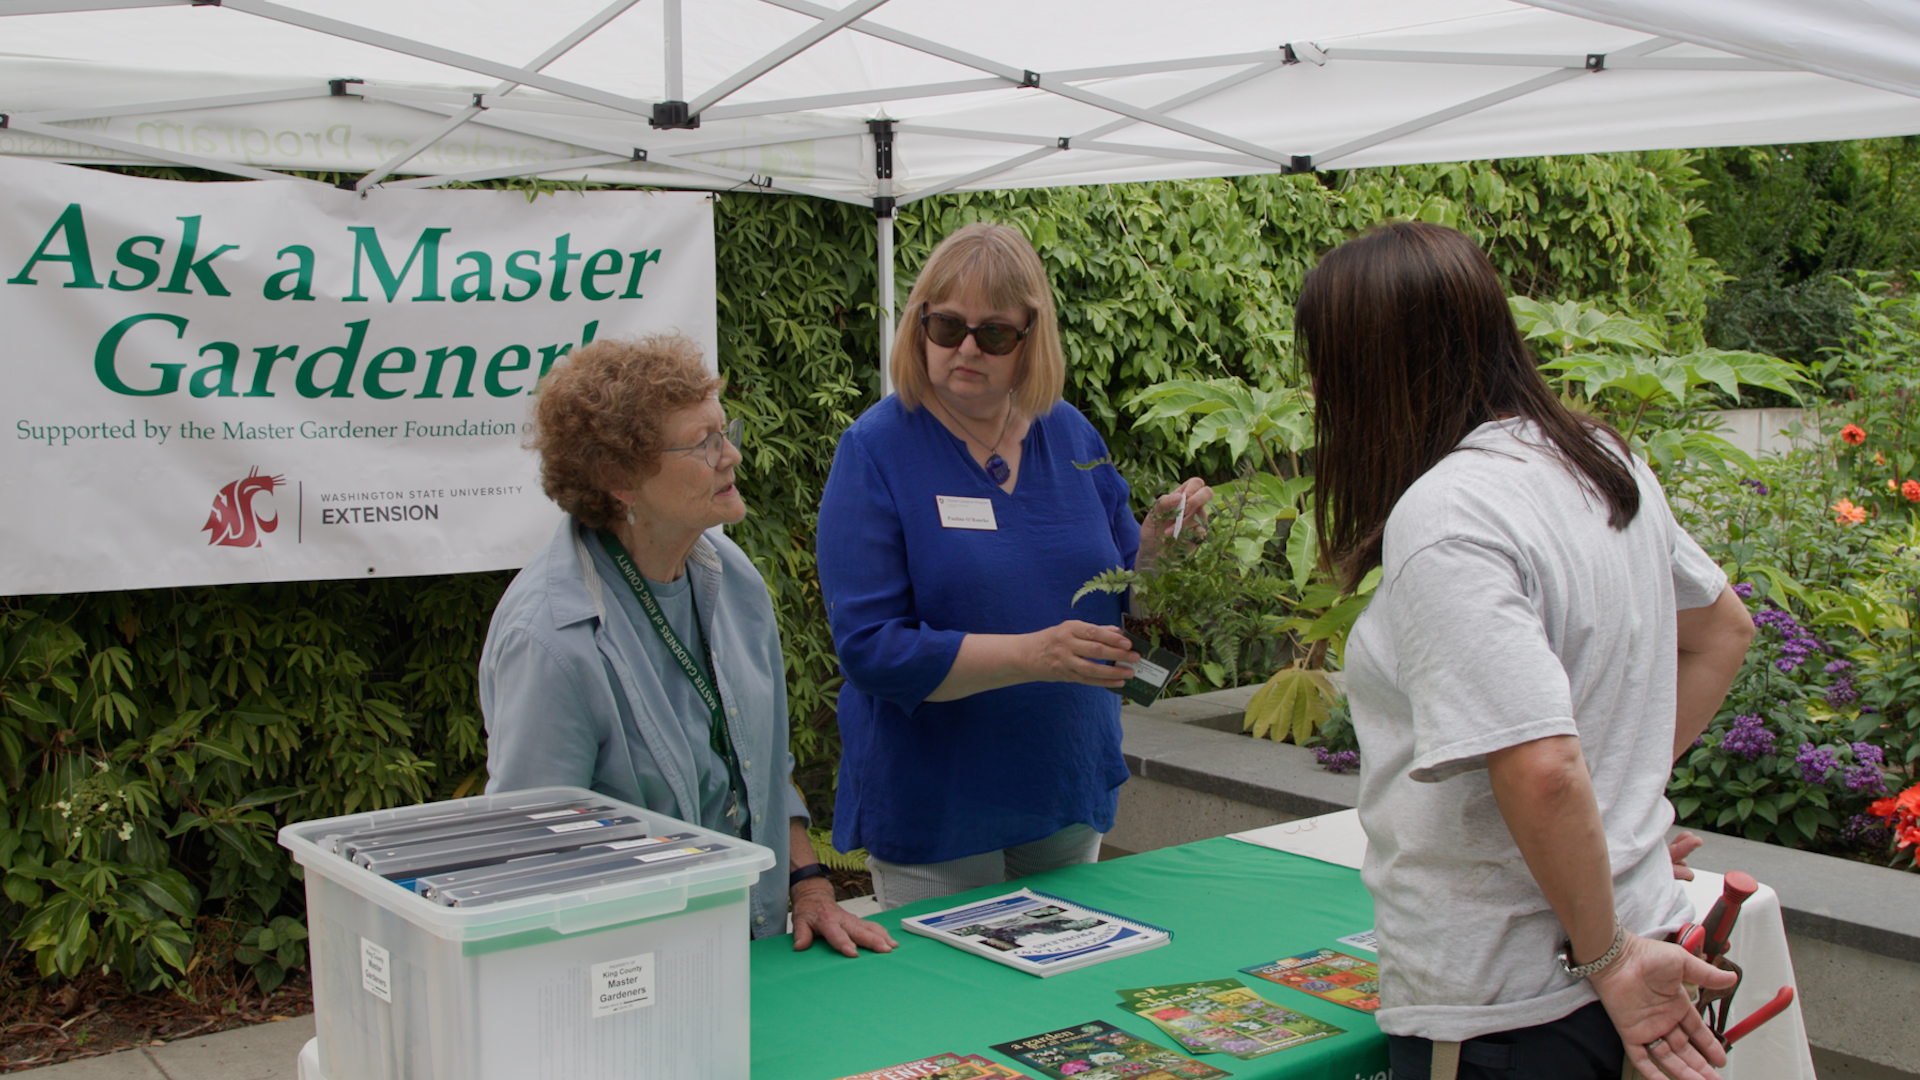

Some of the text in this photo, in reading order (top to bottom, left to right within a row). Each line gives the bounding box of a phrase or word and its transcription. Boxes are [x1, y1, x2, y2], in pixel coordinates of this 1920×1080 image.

[7, 203, 662, 303] Ask a Master
[16, 419, 136, 446] Supported
[144, 419, 172, 445] by
[180, 420, 215, 440] the
[222, 421, 295, 440] Master
[300, 420, 398, 439] Gardener
[404, 419, 516, 438] Foundation
[320, 486, 523, 502] WASHINGTON STATE UNIVERSITY
[322, 504, 439, 525] EXTENSION
[614, 554, 645, 592] COUNTY
[640, 591, 658, 616] KING
[660, 625, 698, 677] GARDENERS
[694, 675, 718, 711] MASTER
[602, 965, 643, 979] King County
[608, 976, 639, 989] Master
[600, 986, 647, 1003] Gardeners
